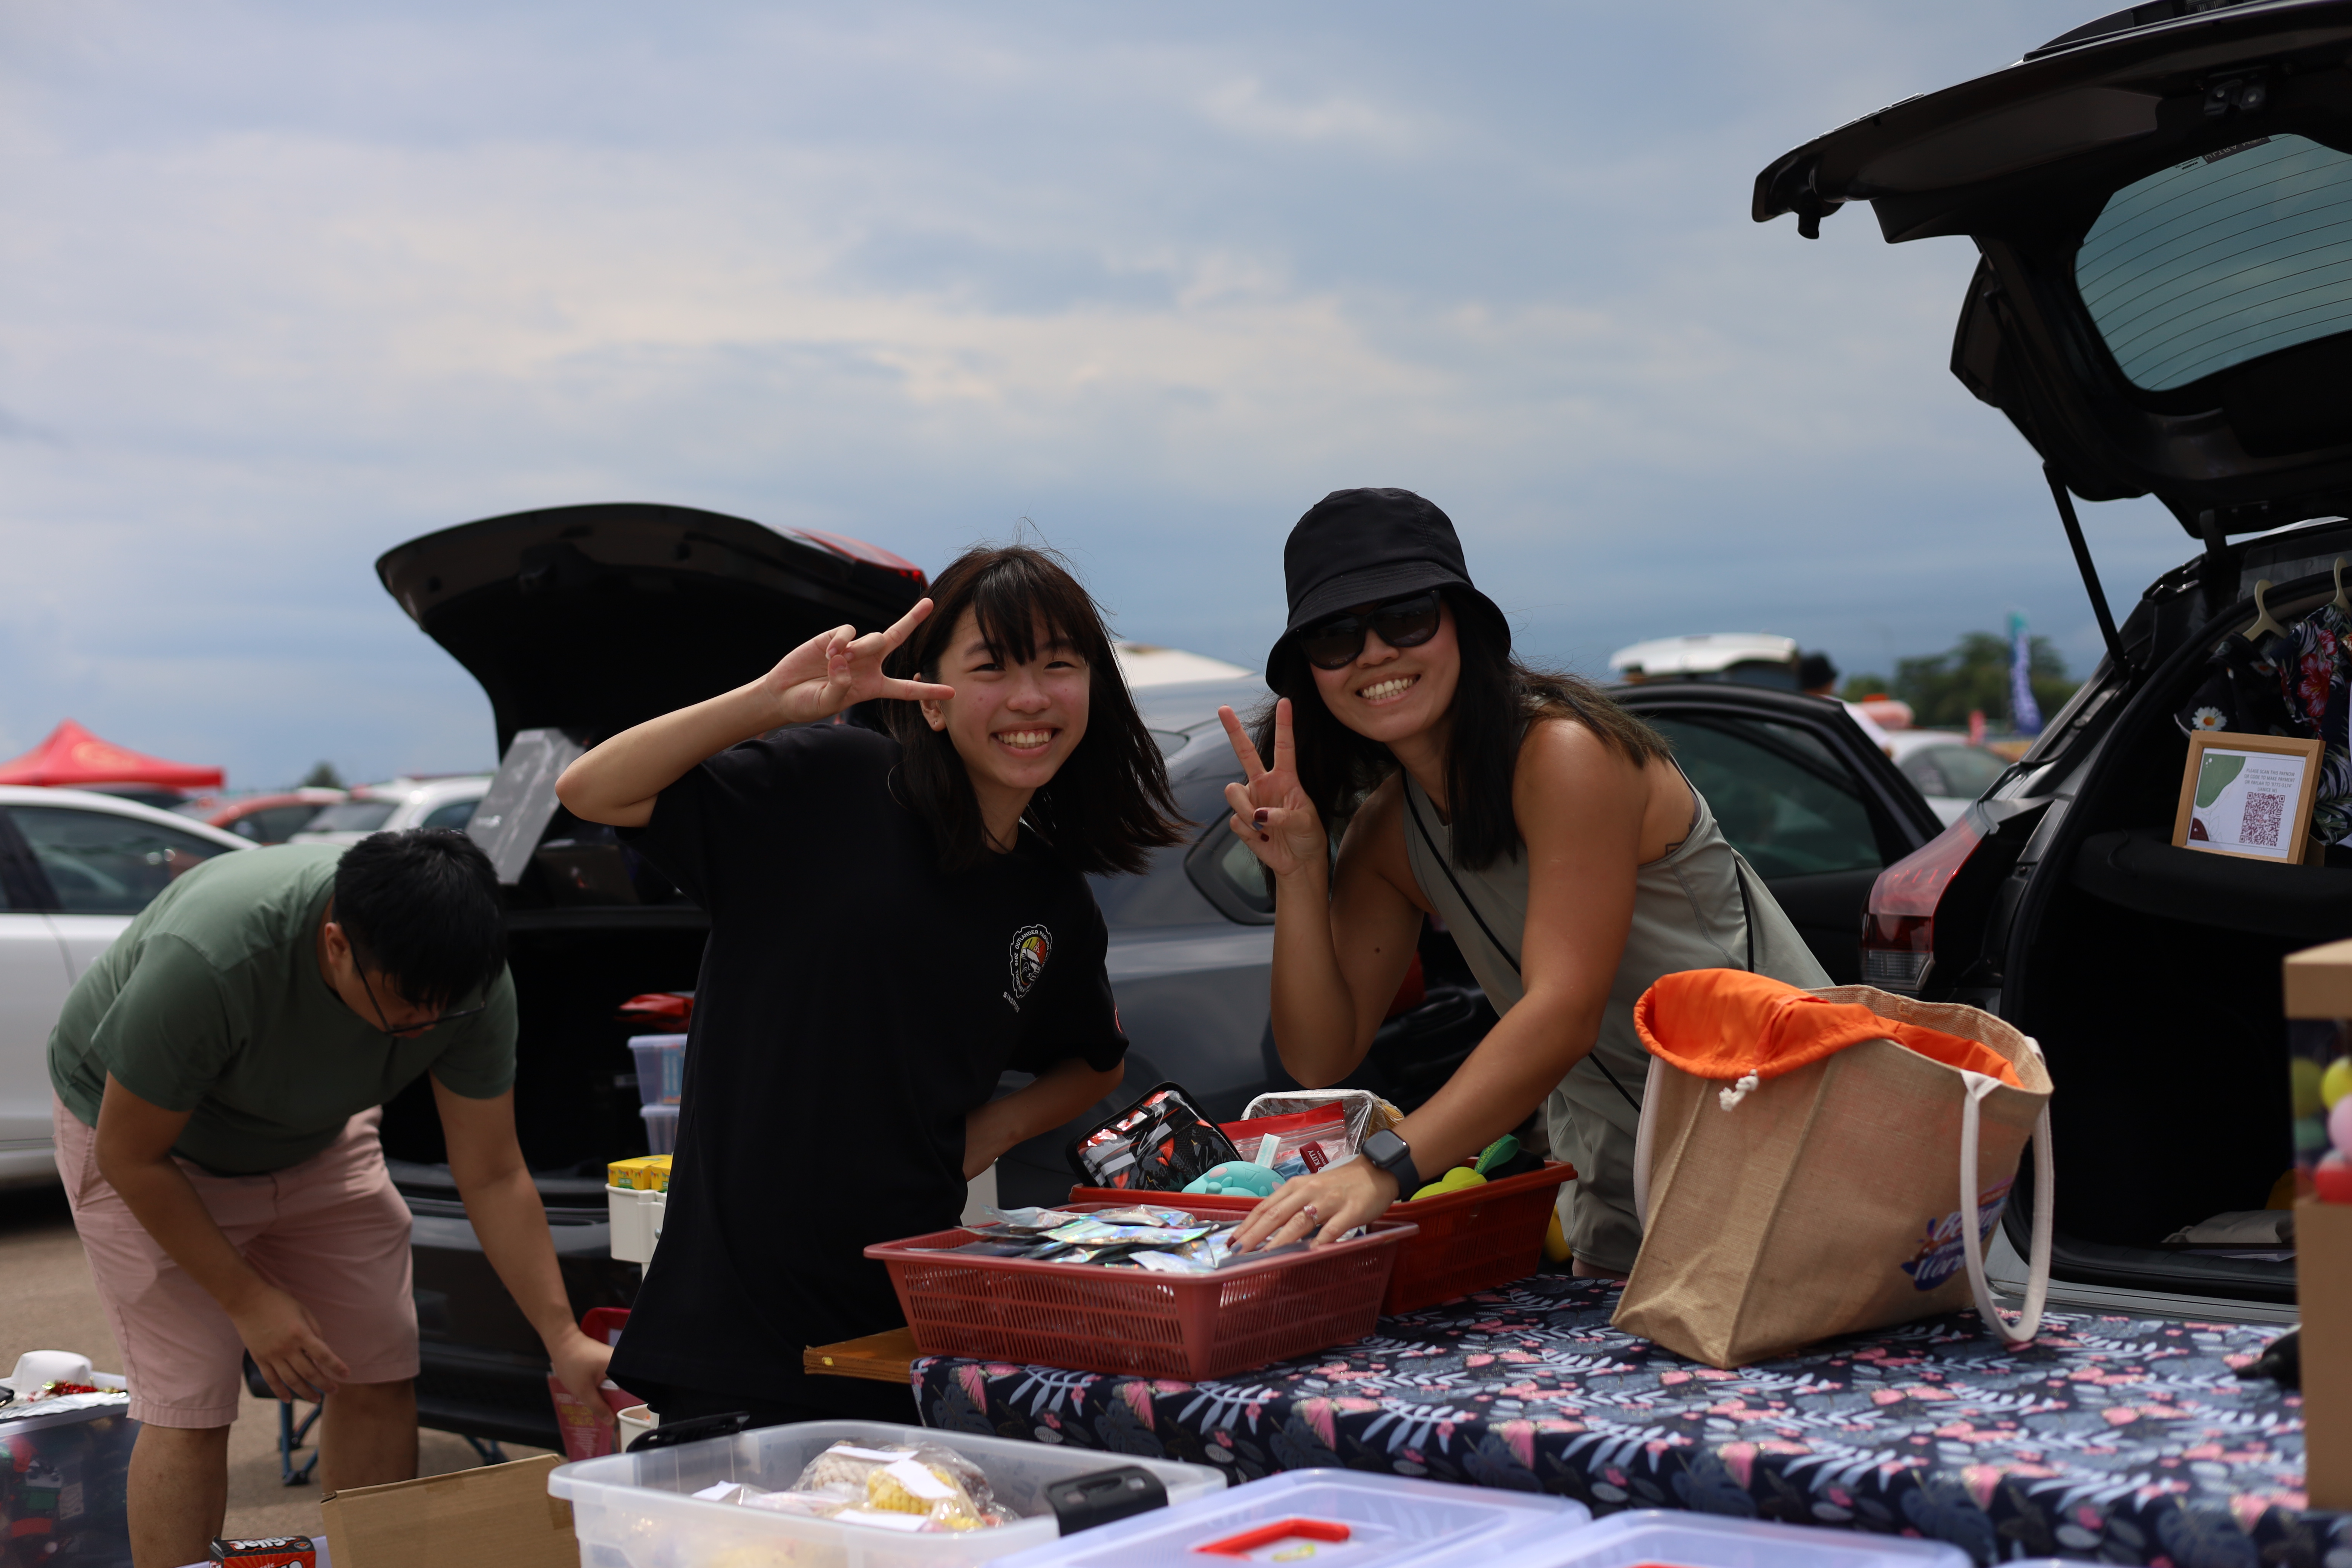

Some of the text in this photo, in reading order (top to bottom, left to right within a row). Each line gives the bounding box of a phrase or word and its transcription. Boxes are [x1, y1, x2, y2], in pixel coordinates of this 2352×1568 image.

[1015, 929, 1038, 949] OUTLANDER
[1039, 931, 1049, 951] PASSION
[1307, 1150, 1321, 1166] KITTY
[1316, 1150, 1327, 1165] aracters
[230, 1536, 296, 1550] Jenga
